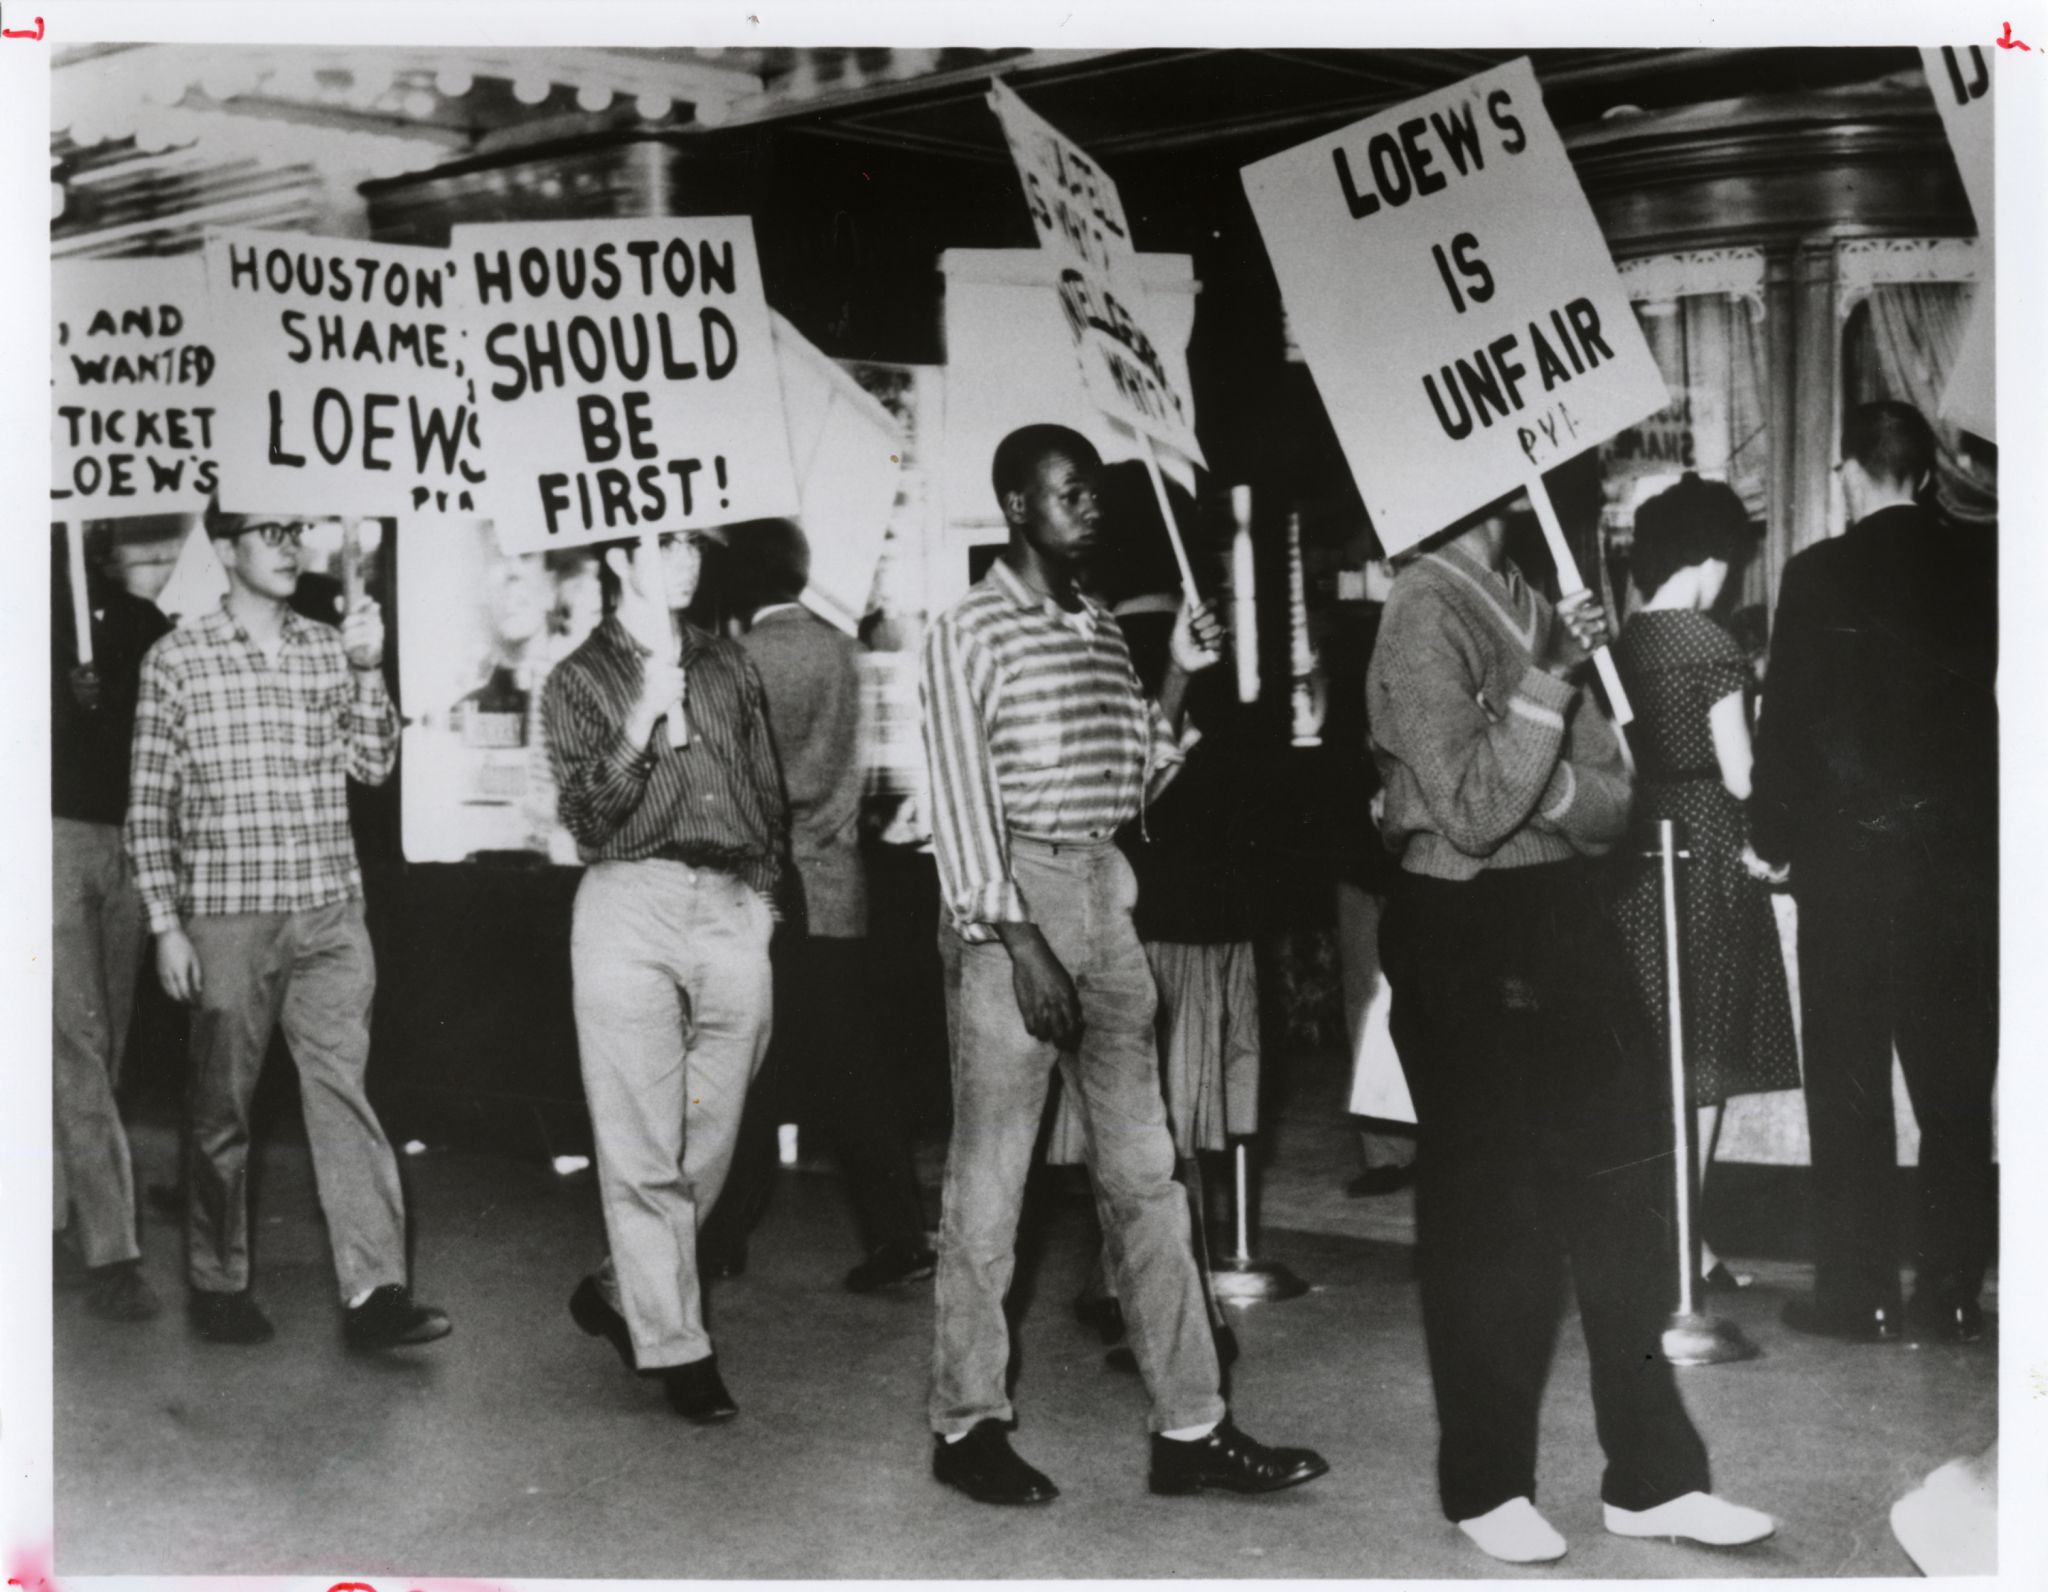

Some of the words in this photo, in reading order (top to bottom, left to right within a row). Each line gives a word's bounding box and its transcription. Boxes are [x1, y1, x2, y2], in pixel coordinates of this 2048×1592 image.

[1332, 87, 1526, 220] LOEW'S
[474, 238, 736, 304] HOUSTON
[1432, 232, 1495, 314] IS
[88, 305, 183, 338] AND
[486, 307, 737, 401] SHOULD
[71, 345, 215, 387] WANTED
[1422, 298, 1614, 441] UNFAIR
[59, 406, 215, 449] TICKET
[577, 392, 658, 463] BE
[538, 455, 728, 534] FIRST!
